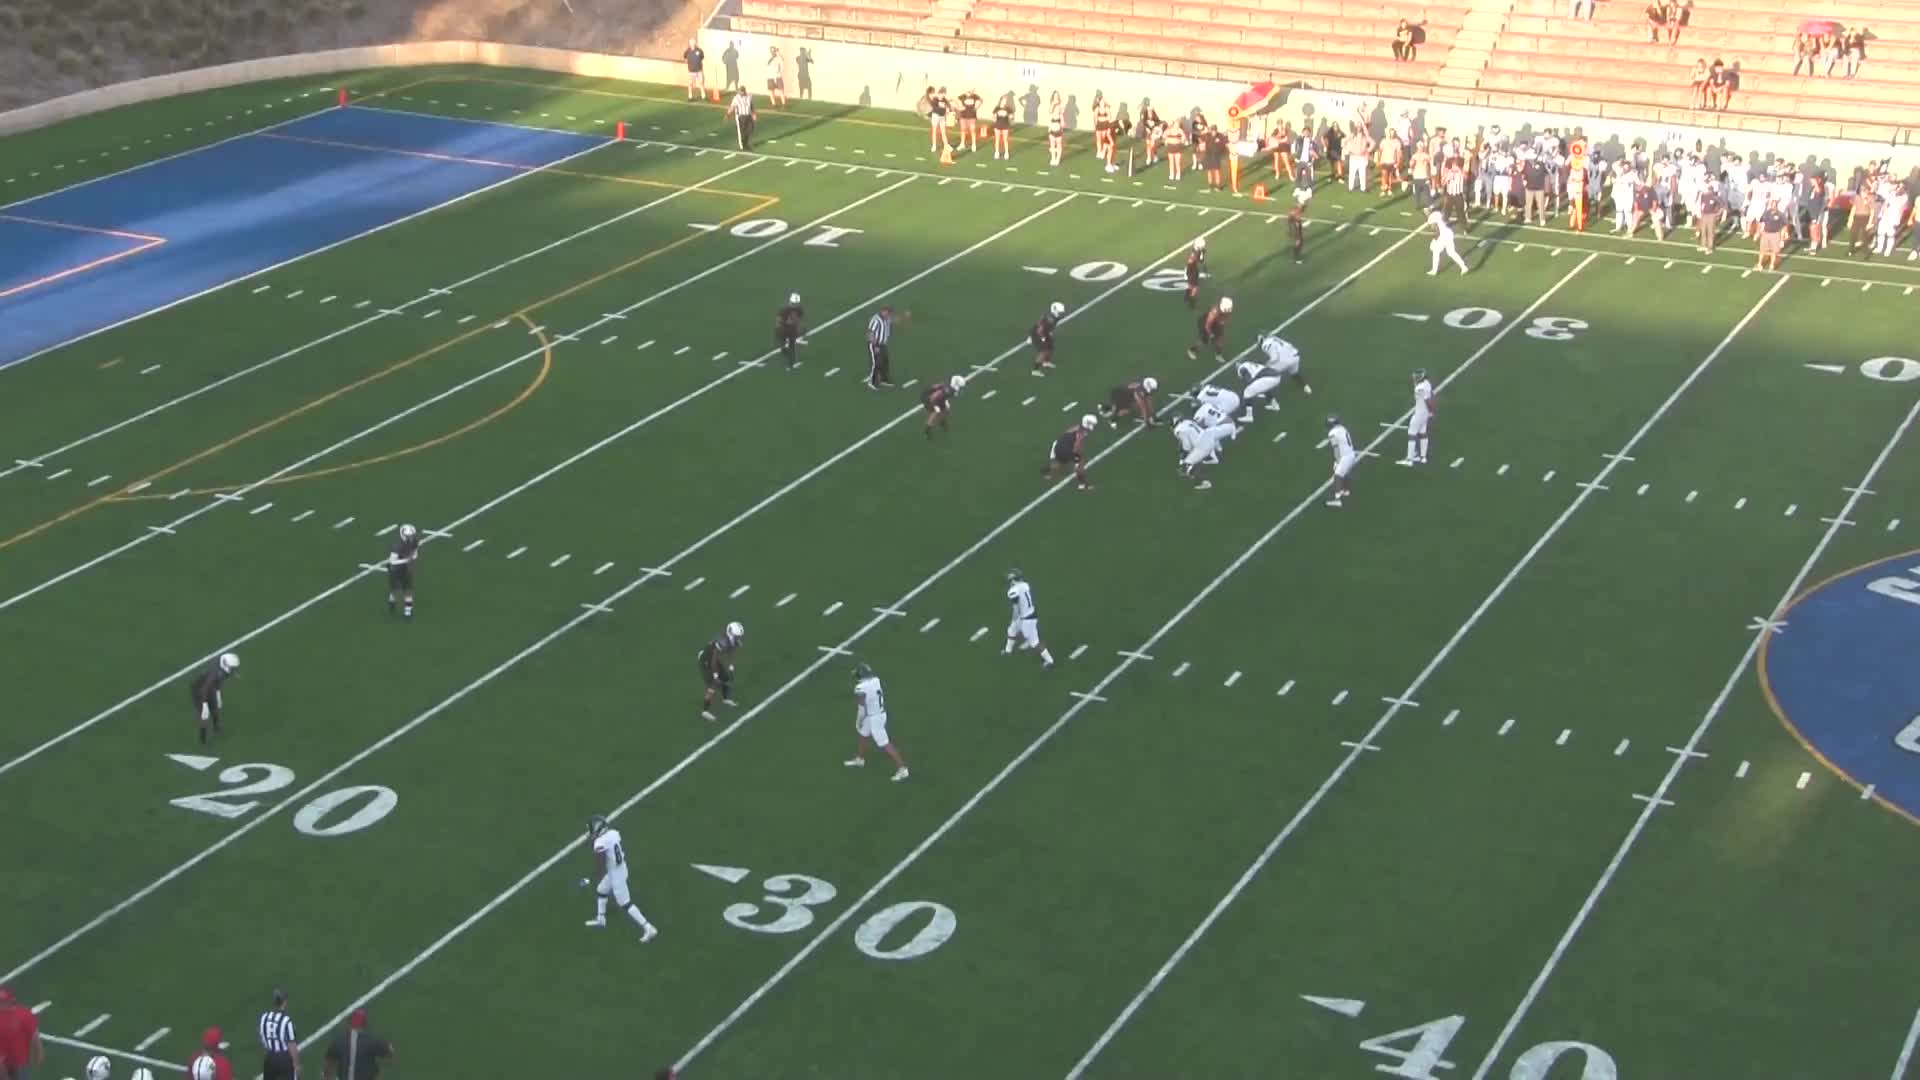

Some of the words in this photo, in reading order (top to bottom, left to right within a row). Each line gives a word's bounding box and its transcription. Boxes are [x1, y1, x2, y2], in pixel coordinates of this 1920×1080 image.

[1443, 307, 1590, 340] 30
[169, 762, 398, 836] 20
[723, 873, 956, 959] 30
